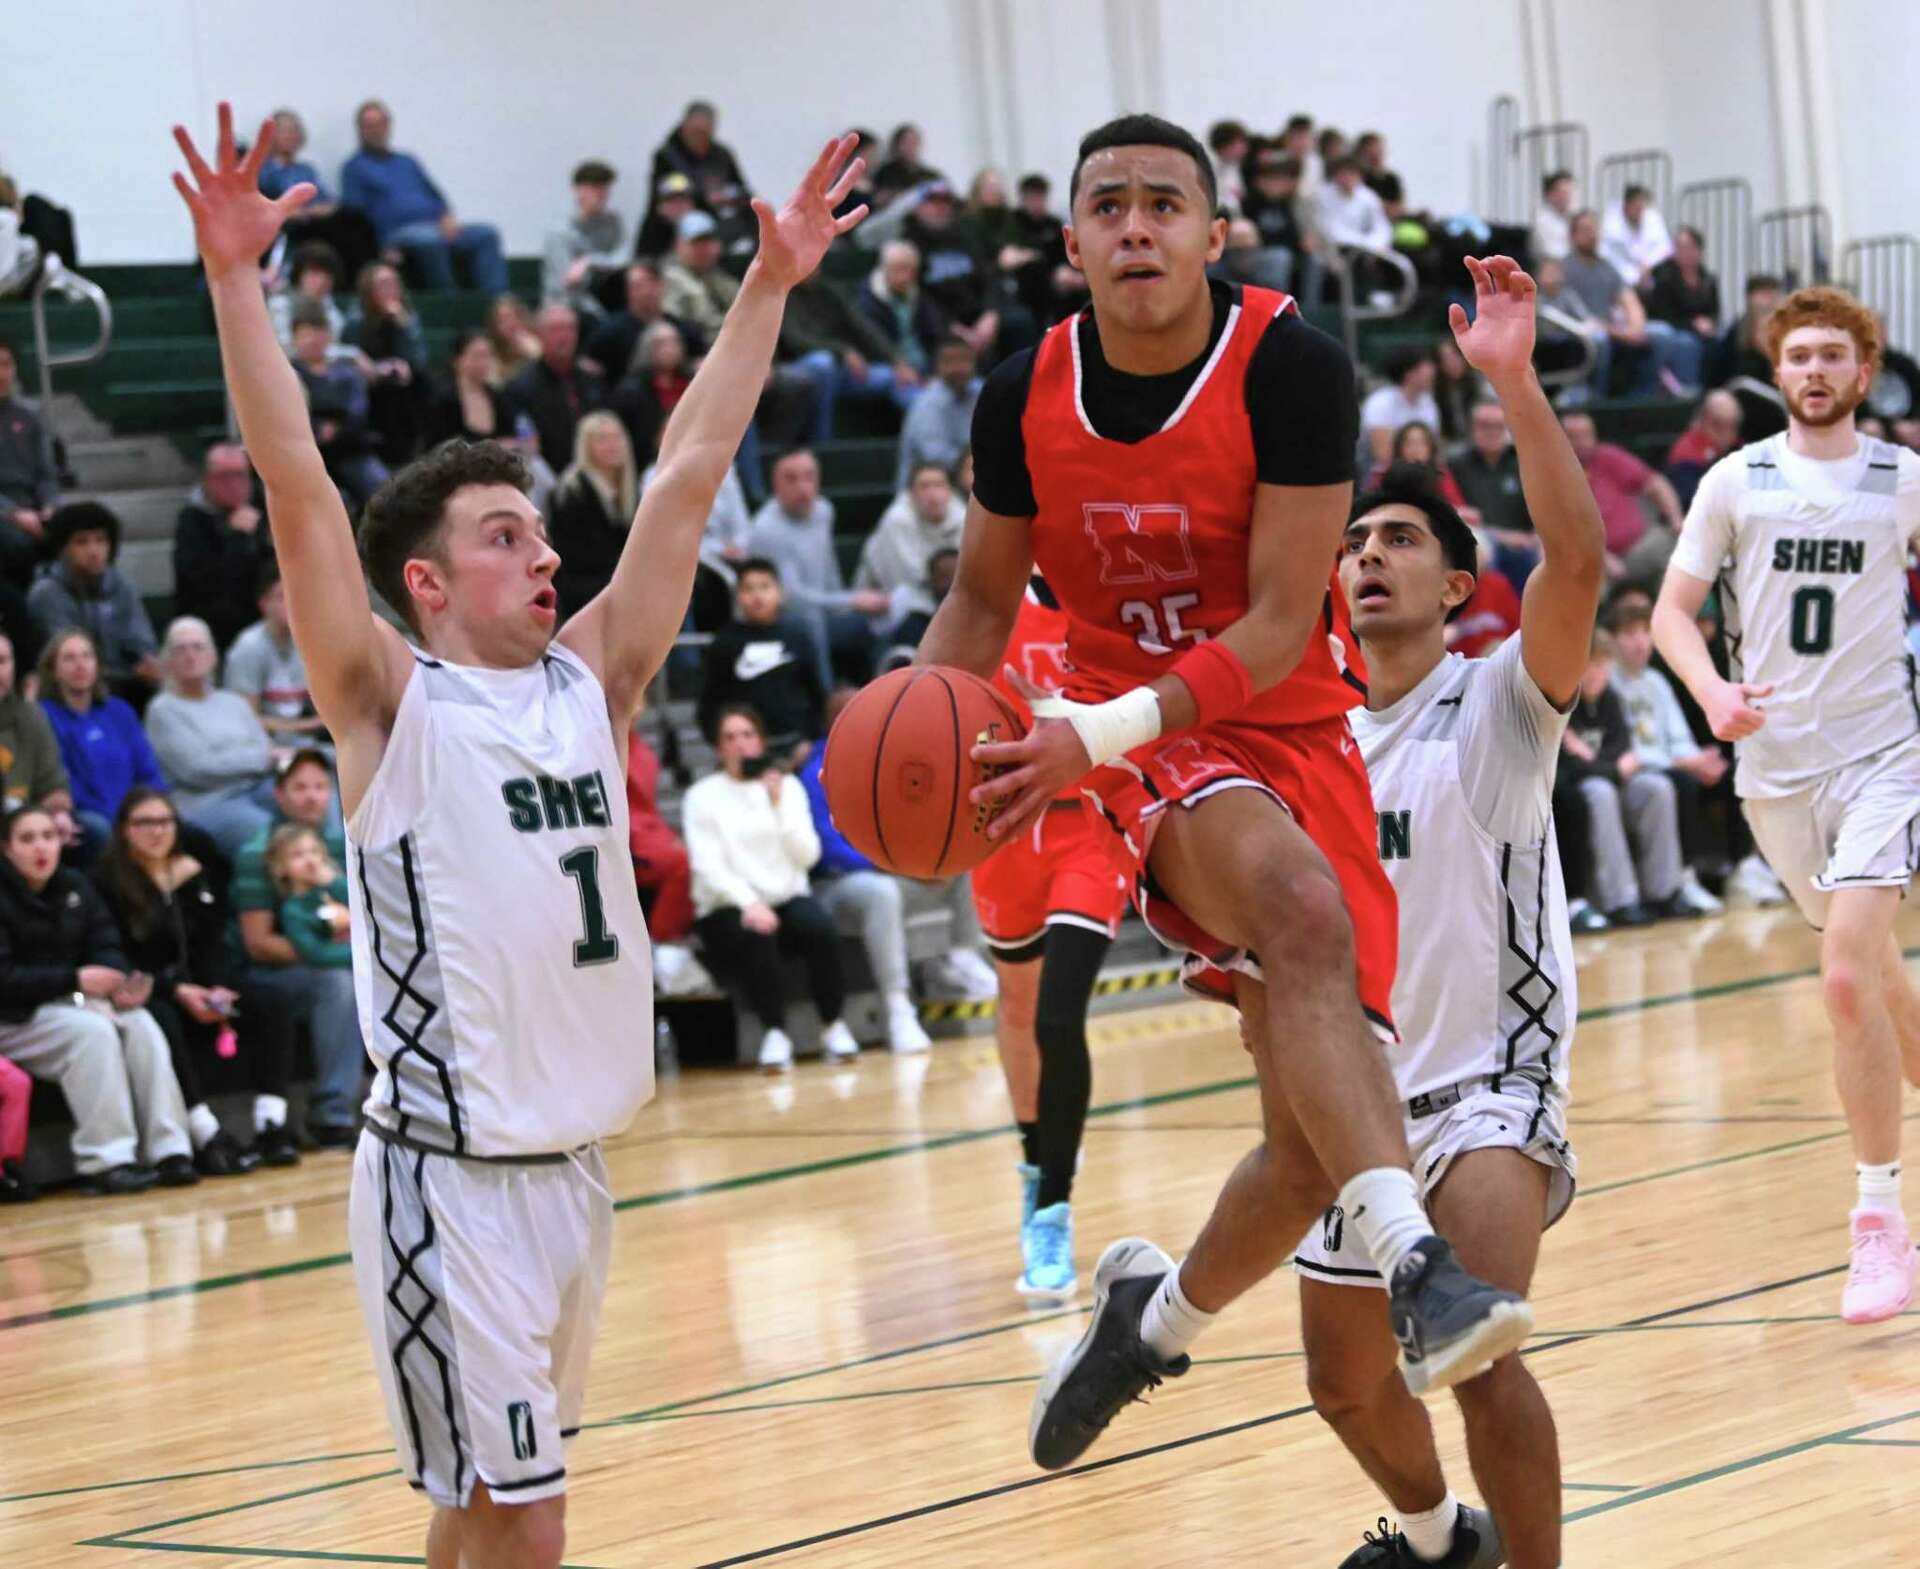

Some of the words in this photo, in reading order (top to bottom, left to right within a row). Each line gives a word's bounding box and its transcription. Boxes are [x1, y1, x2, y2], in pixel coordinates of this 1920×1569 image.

[1082, 503, 1198, 585] N
[1772, 538, 1865, 574] SHEN
[1790, 585, 1835, 657] 0
[501, 769, 613, 833] SHE
[558, 845, 619, 968] 1
